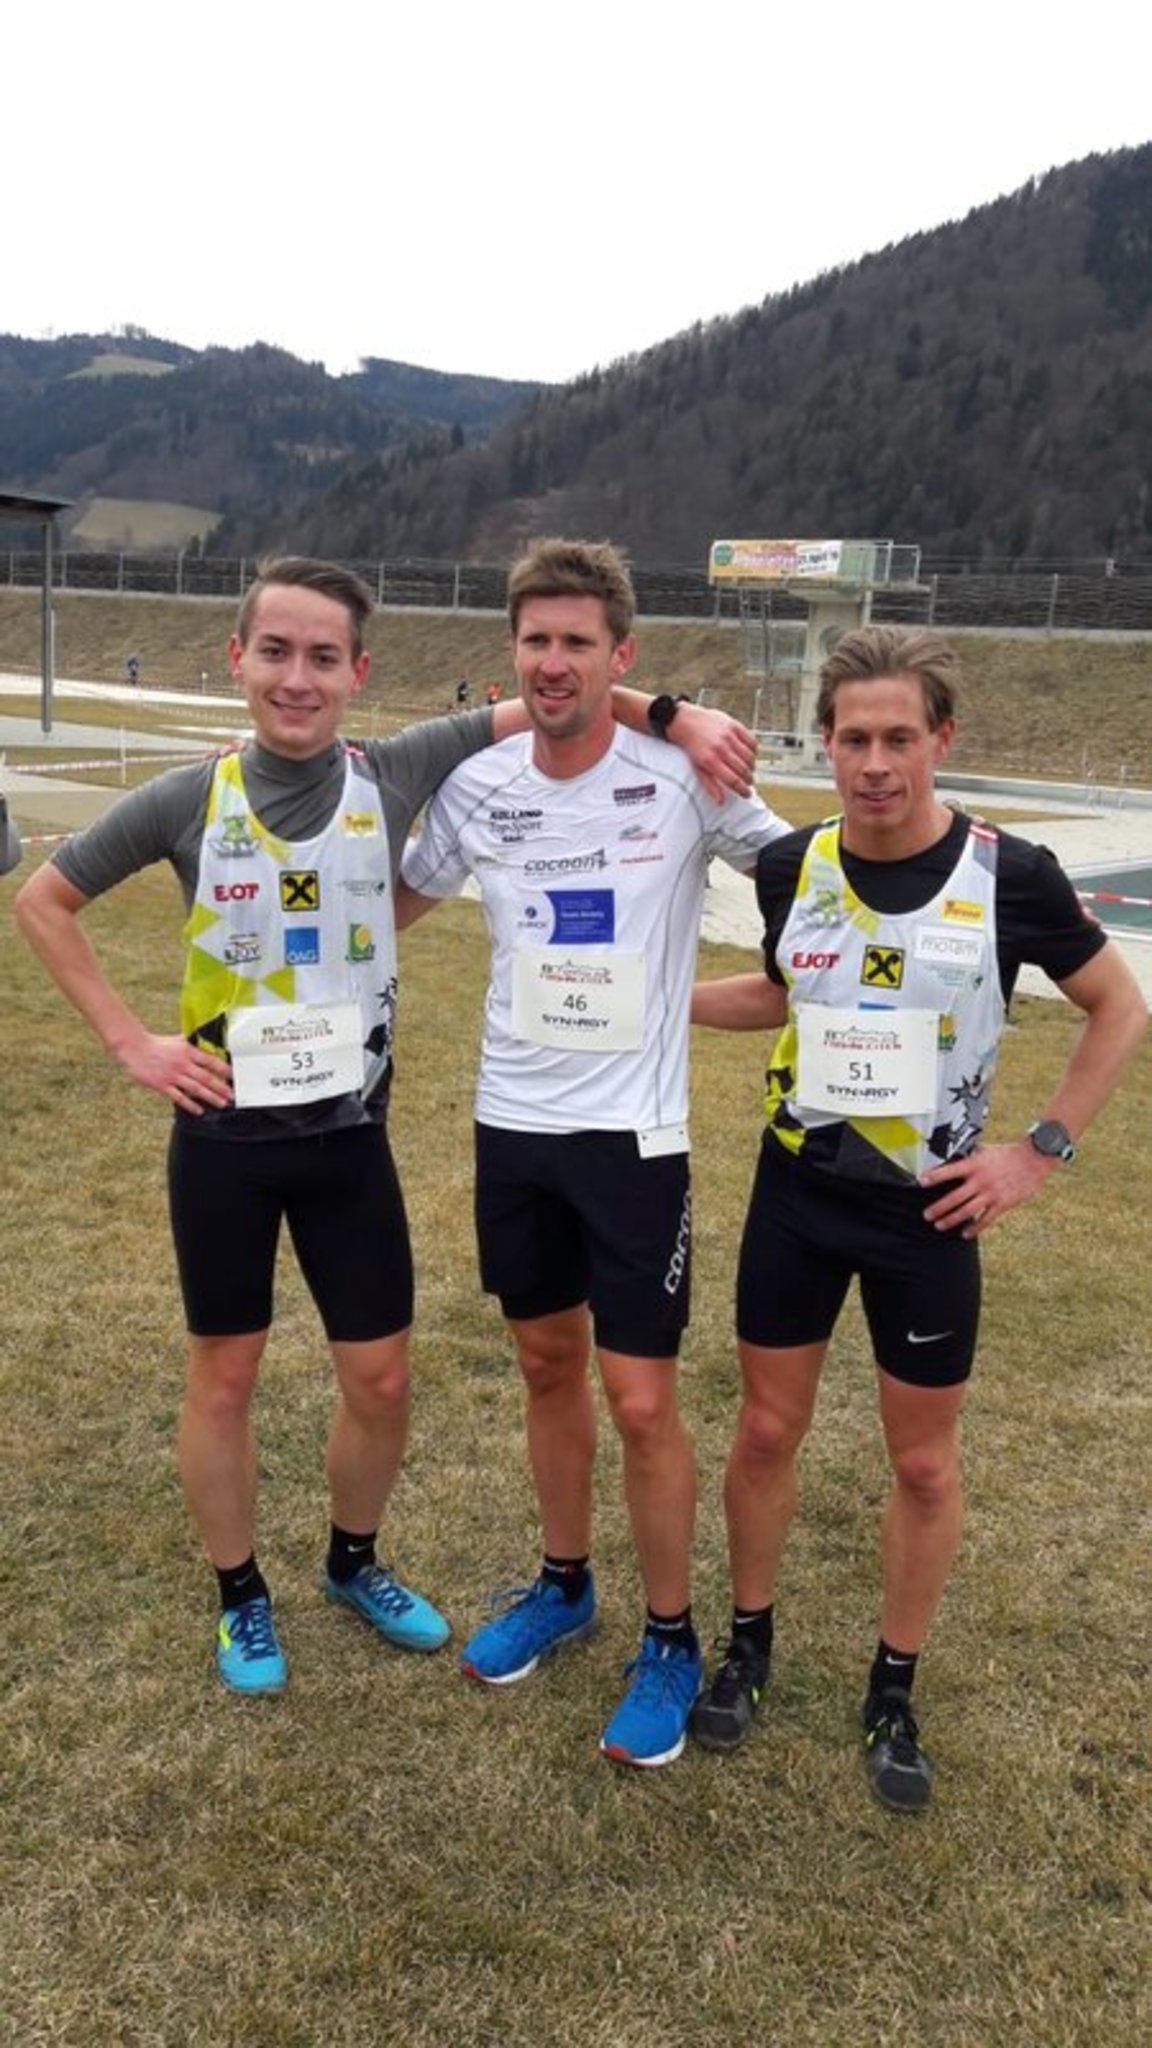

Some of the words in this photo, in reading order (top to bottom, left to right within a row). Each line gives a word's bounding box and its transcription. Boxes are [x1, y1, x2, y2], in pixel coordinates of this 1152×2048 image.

[791, 951, 840, 969] EJOT
[563, 994, 587, 1012] 46
[291, 1051, 314, 1071] 53
[849, 1061, 873, 1081] 51
